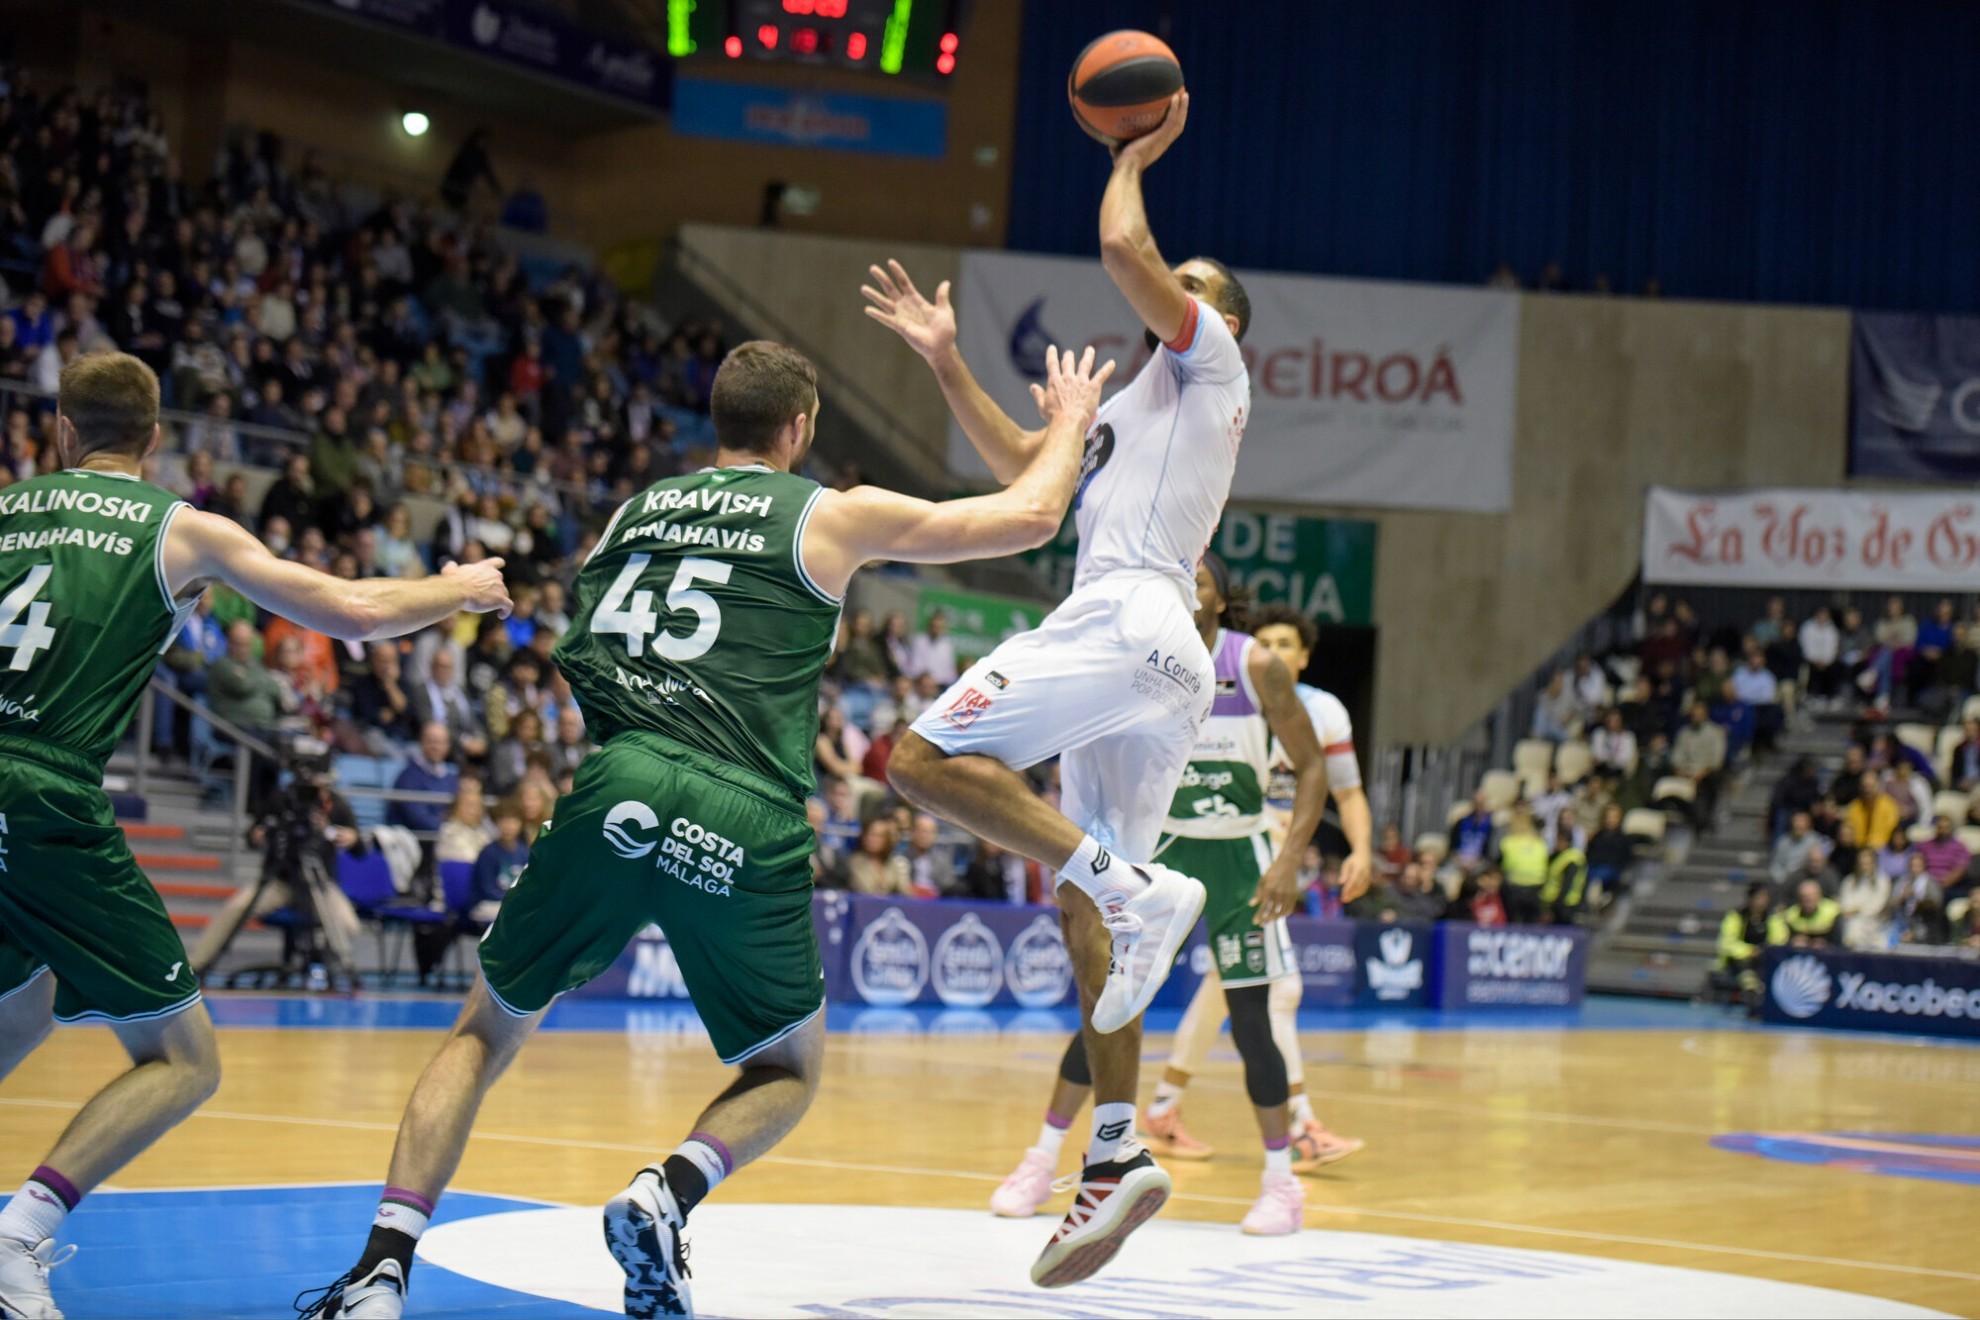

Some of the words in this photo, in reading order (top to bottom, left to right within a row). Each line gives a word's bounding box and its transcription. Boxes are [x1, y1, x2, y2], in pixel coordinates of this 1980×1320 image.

[0, 489, 152, 523] KALINOSKI
[642, 488, 773, 518] KRAVISH
[1220, 512, 1298, 564] DE
[1668, 501, 1744, 567] La
[1862, 504, 1913, 568] de
[0, 564, 56, 672] 4
[590, 552, 734, 662] 45
[1146, 649, 1159, 667] A
[1164, 655, 1202, 694] Coruña
[661, 836, 696, 867] DEL
[697, 855, 736, 885] SOL
[671, 817, 745, 868] COSTA
[656, 854, 731, 898] MÁLAGA
